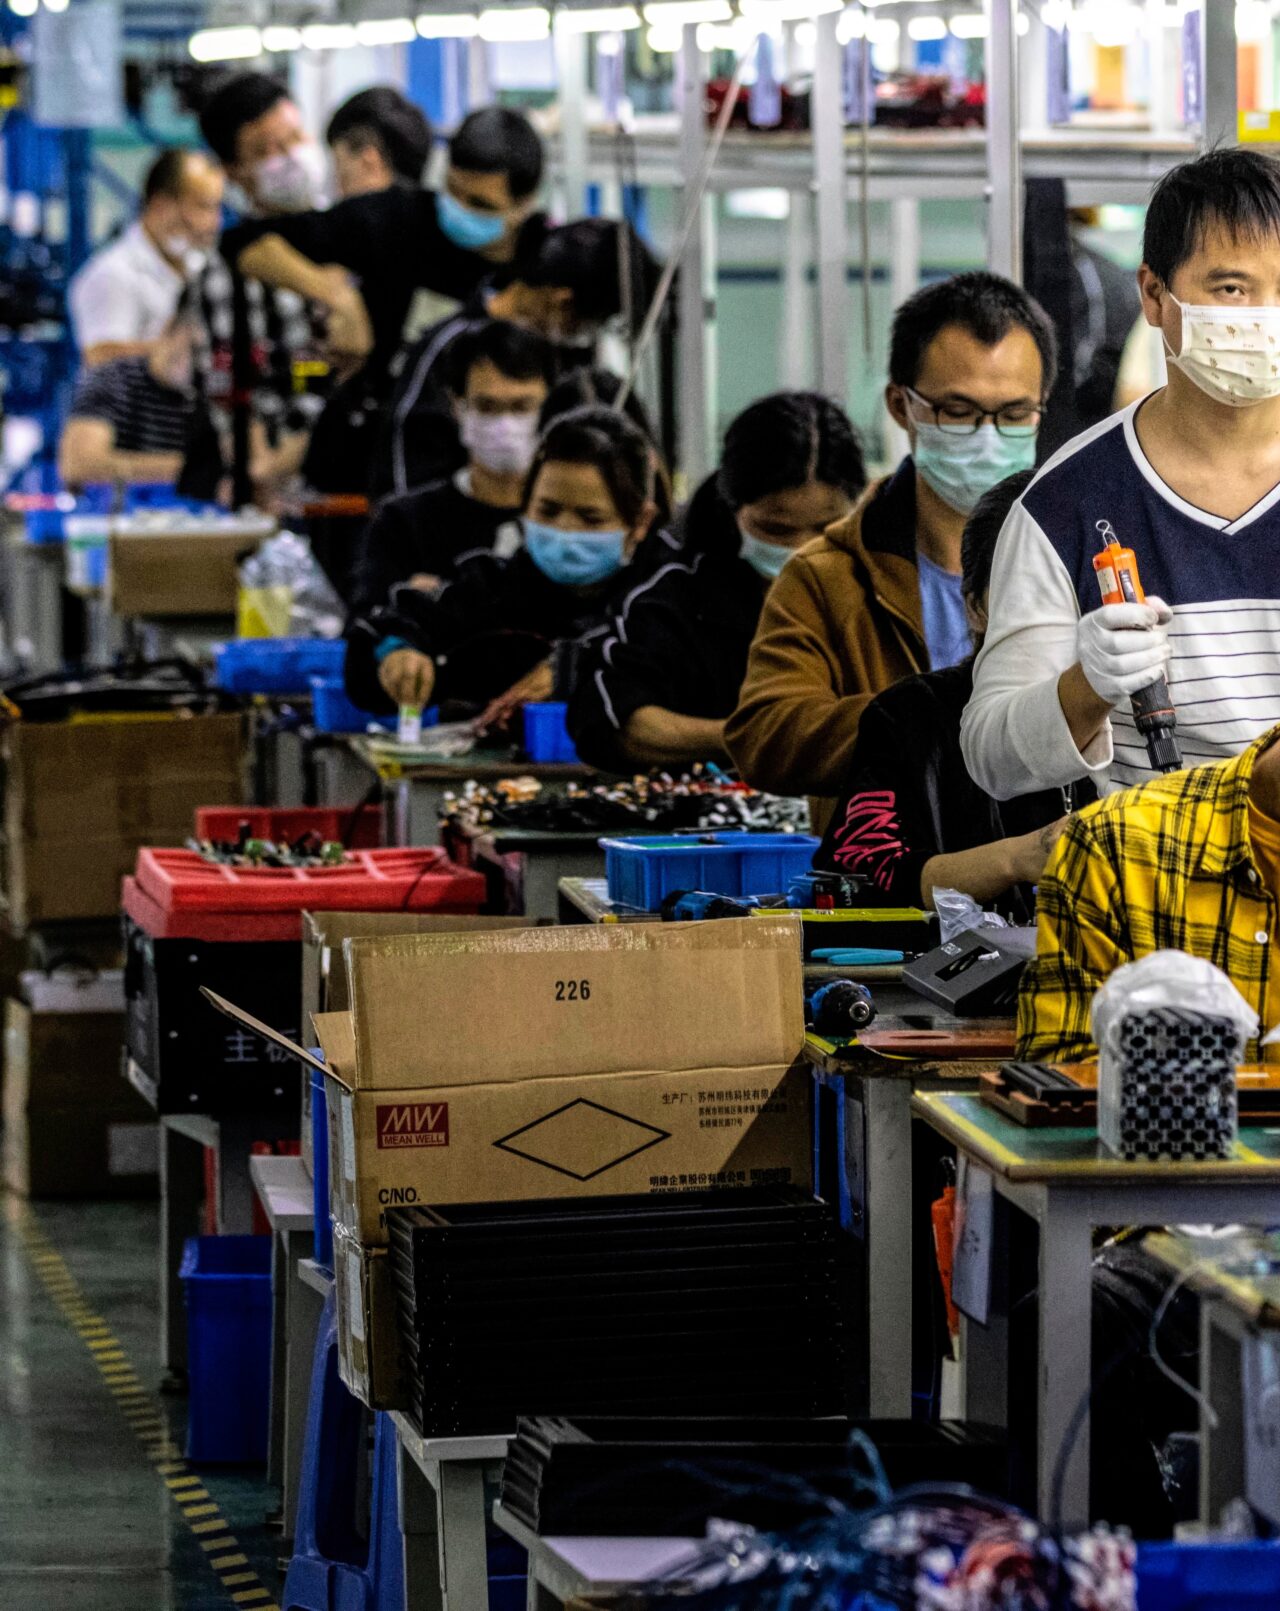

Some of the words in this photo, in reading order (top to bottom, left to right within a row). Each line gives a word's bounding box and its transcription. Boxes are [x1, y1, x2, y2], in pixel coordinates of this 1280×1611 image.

[555, 979, 591, 1001] 226
[382, 1105, 444, 1132] MW
[385, 1134, 413, 1145] MEAN
[415, 1133, 443, 1143] WELL
[379, 1187, 421, 1204] C/NO.
